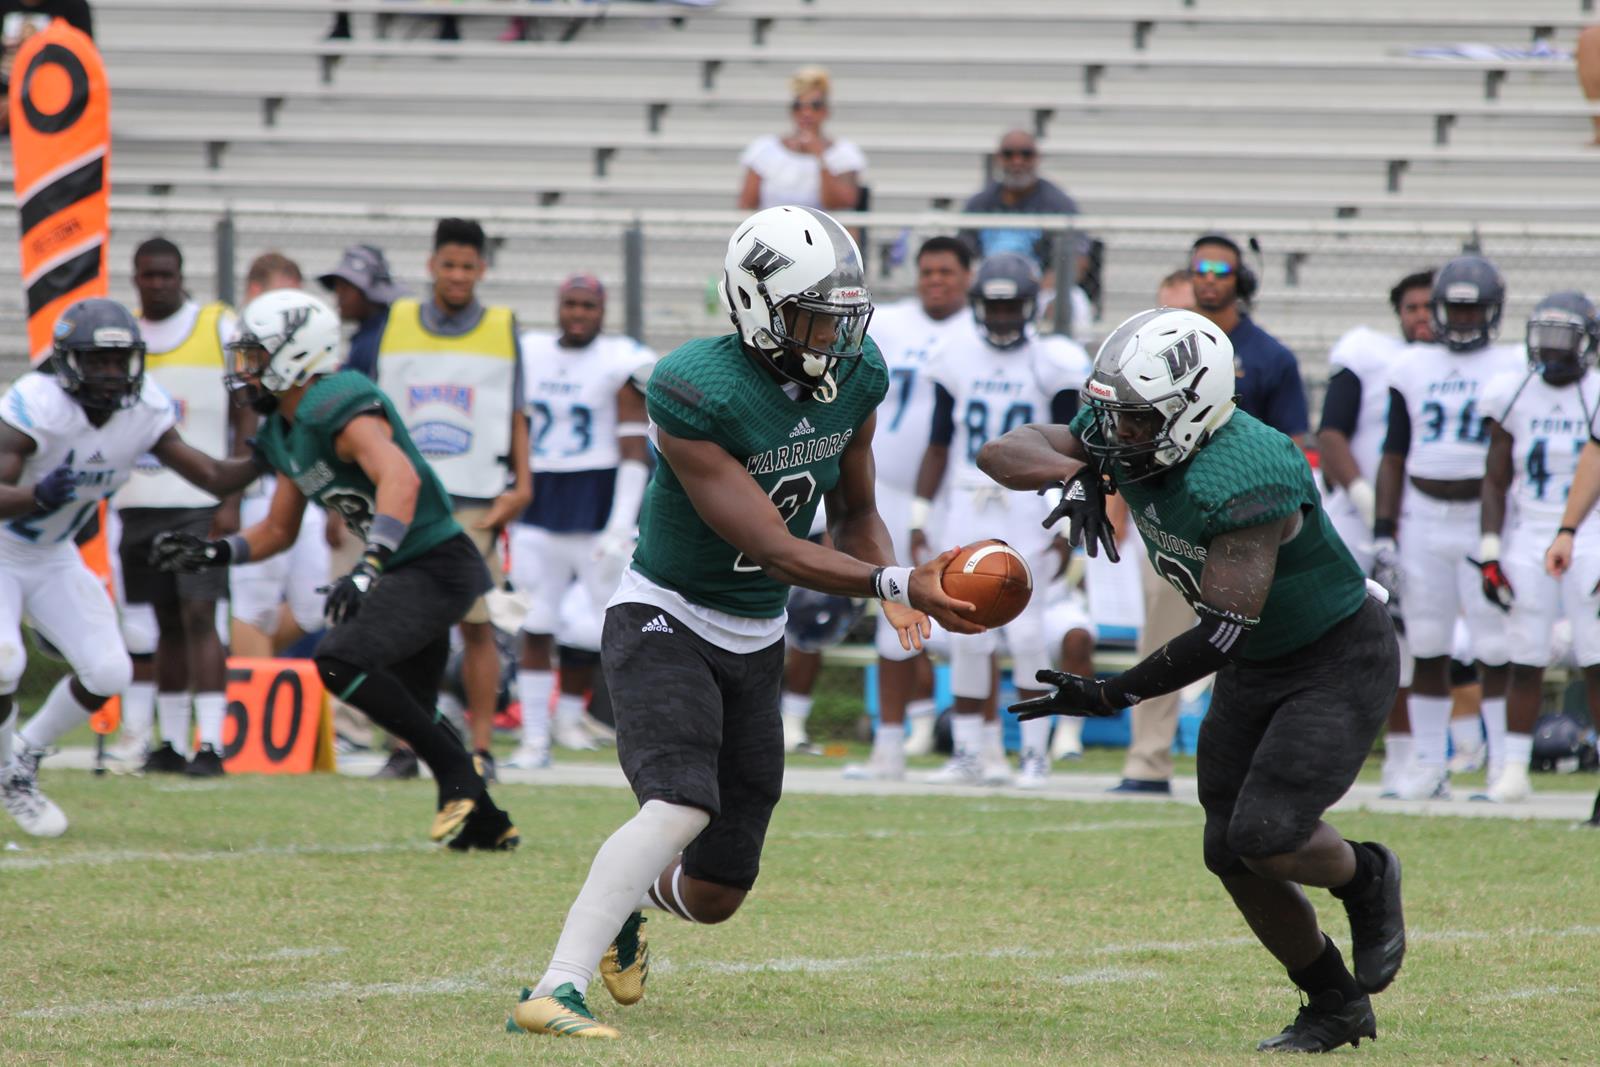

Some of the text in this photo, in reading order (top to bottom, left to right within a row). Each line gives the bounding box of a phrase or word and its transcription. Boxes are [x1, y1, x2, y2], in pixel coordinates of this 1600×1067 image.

[1156, 329, 1201, 385] W
[789, 427, 815, 438] adidas
[746, 428, 853, 475] WARRIORS
[76, 469, 116, 487] OINT
[641, 624, 674, 634] adidas
[227, 667, 303, 764] 50
